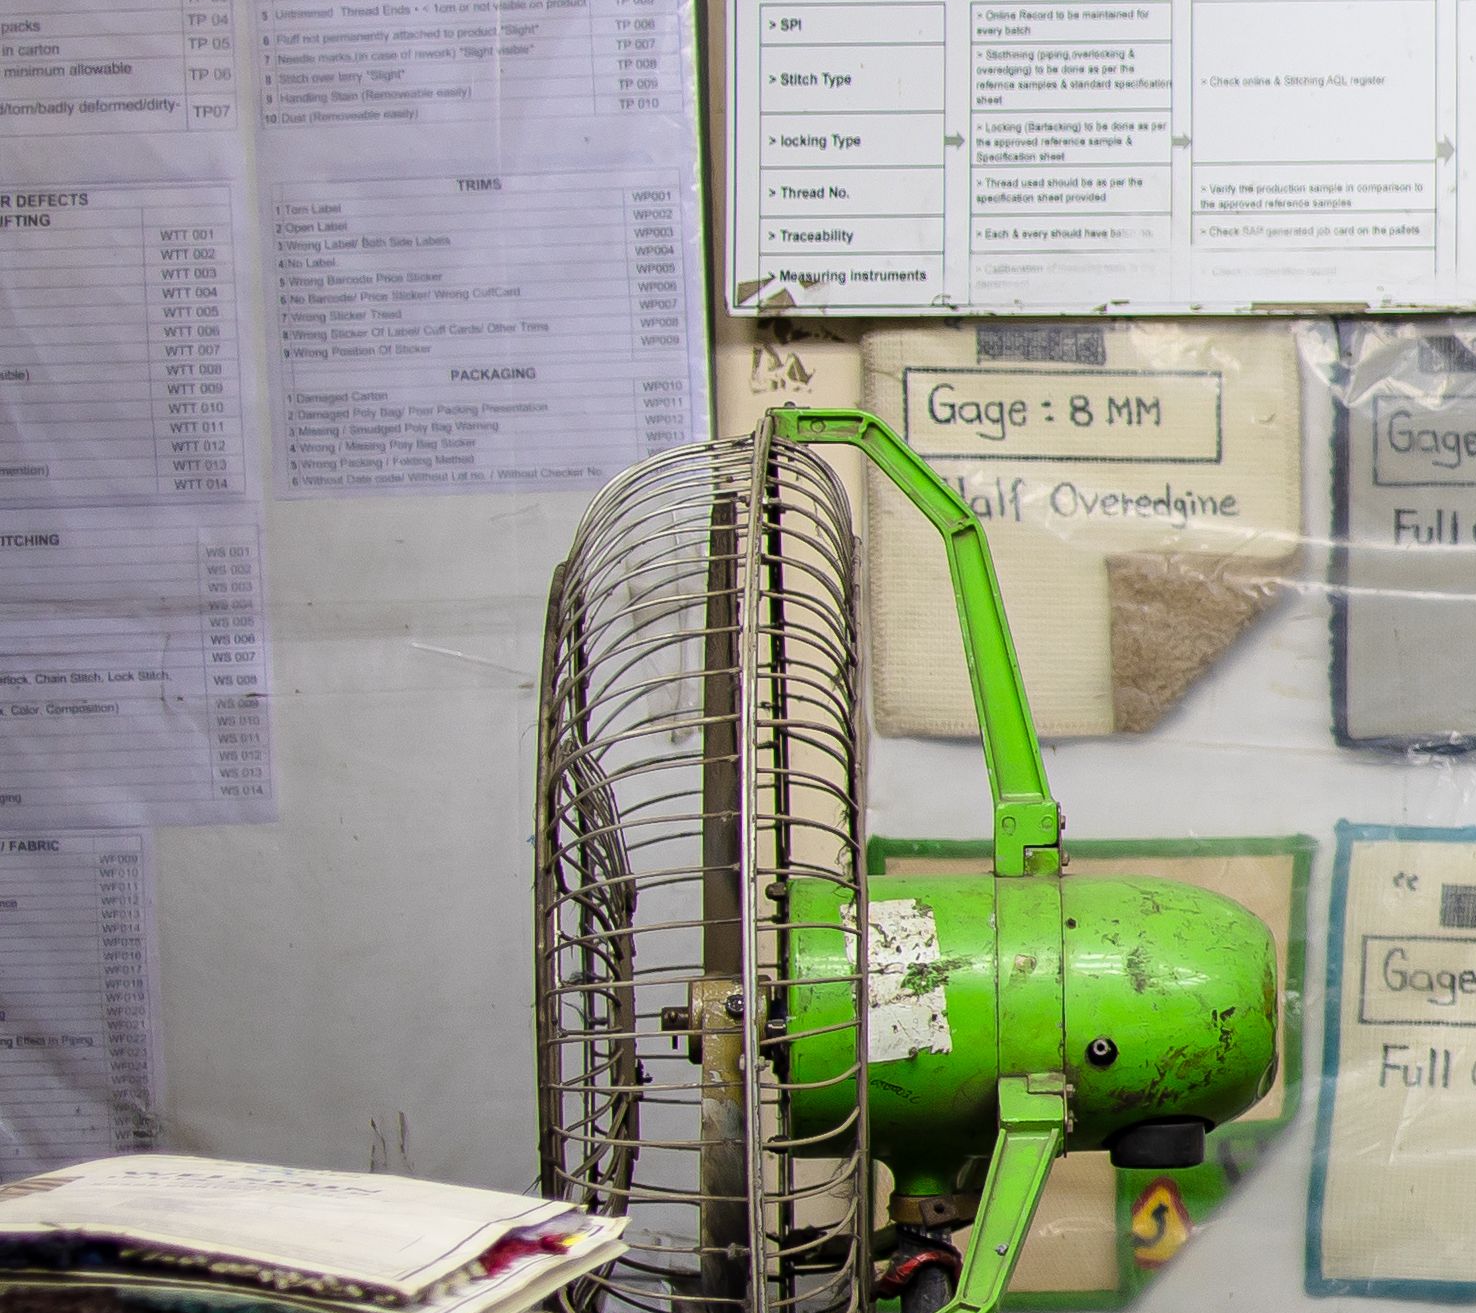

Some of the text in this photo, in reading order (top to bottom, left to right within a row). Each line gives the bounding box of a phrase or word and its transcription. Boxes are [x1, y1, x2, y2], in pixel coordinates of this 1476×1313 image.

[780, 19, 801, 32] SPI
[18, 44, 60, 57] carton
[69, 61, 132, 76] allowable
[780, 74, 852, 88] Stitch Type
[780, 135, 861, 150] locking Type
[456, 178, 502, 192] TRIMS
[781, 186, 850, 199] Thread No.
[16, 193, 88, 208] DEFECTS
[780, 230, 853, 245] Traceability
[780, 270, 846, 284] Measuring
[450, 368, 536, 382] PACKAGING
[1069, 394, 1095, 428] 8
[1106, 396, 1161, 427] MM
[1393, 508, 1458, 546] Full
[1379, 1043, 1450, 1088] Full
